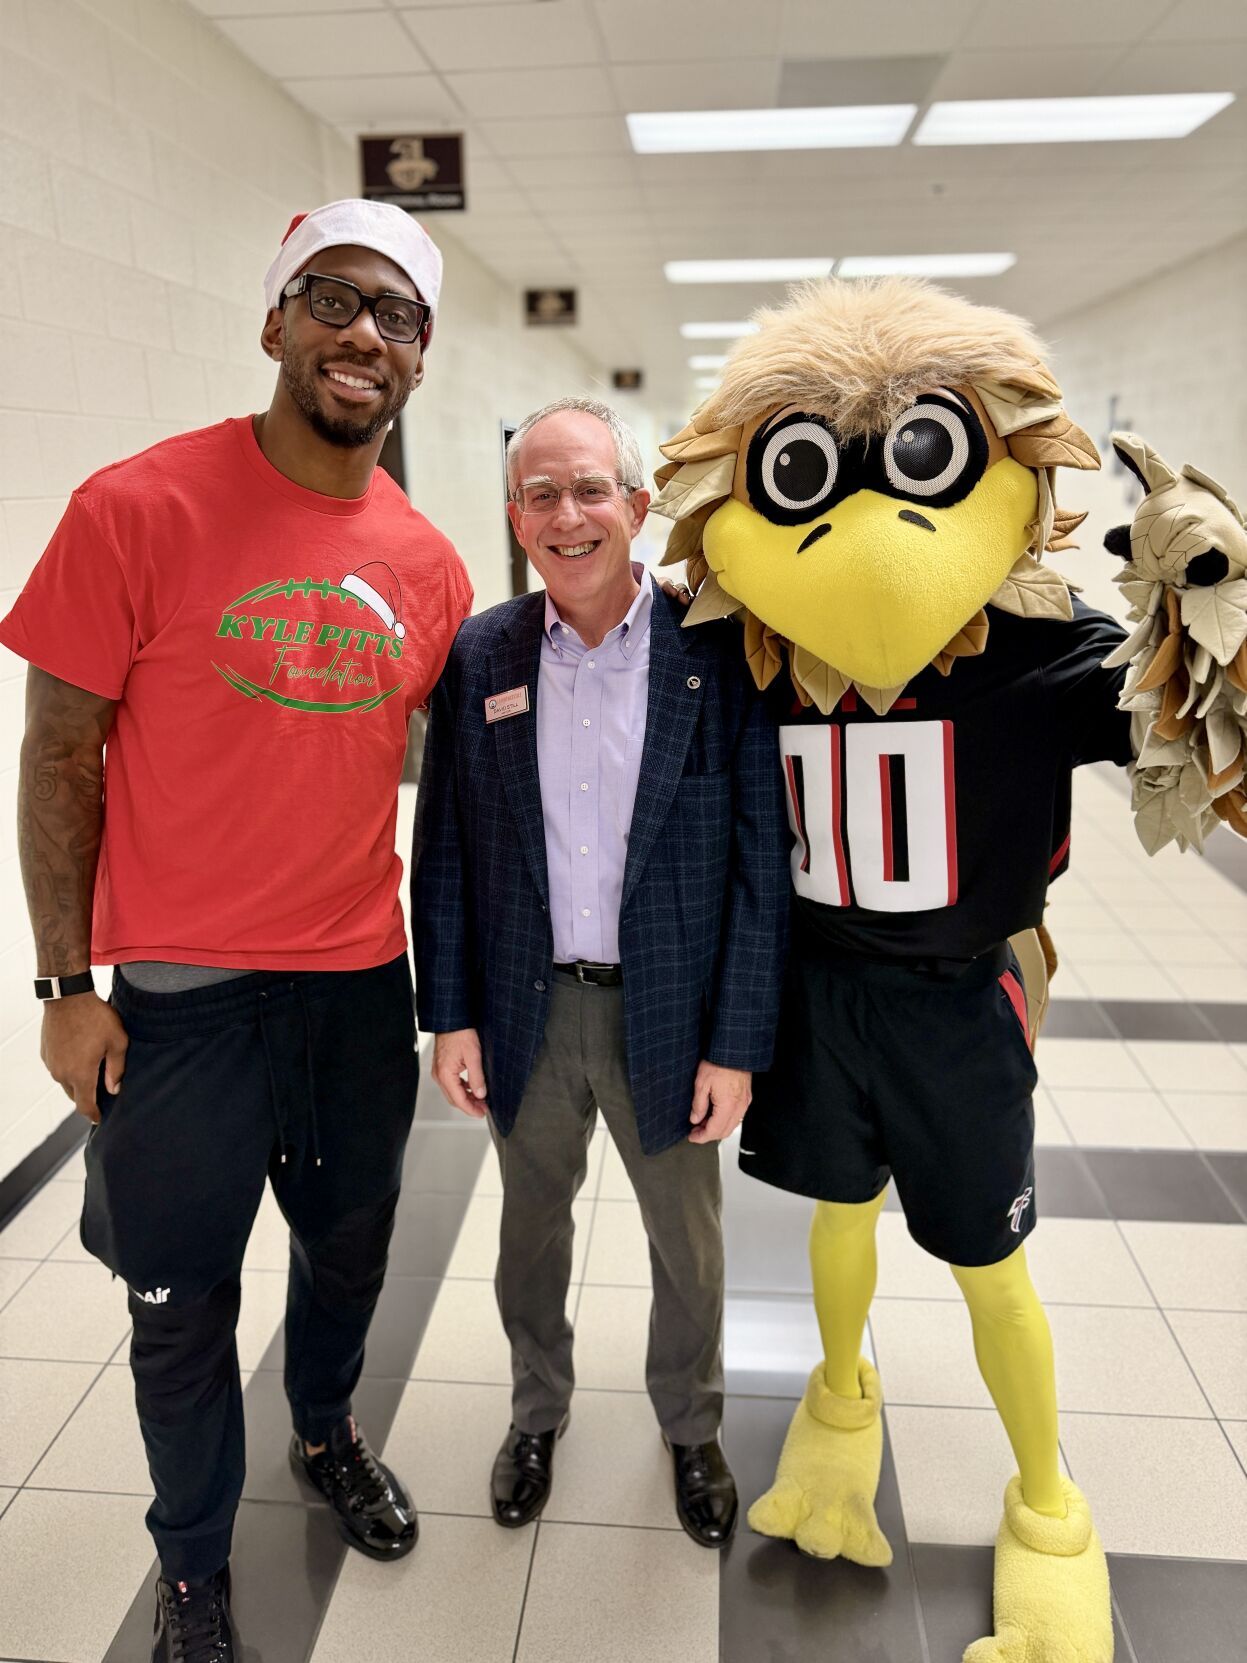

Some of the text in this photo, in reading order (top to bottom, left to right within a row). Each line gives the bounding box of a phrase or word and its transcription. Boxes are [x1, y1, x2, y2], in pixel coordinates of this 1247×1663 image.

[216, 613, 404, 660] KYLE PITTS
[269, 646, 376, 691] Foundation
[779, 720, 958, 912] 00
[144, 1287, 171, 1304] Air
